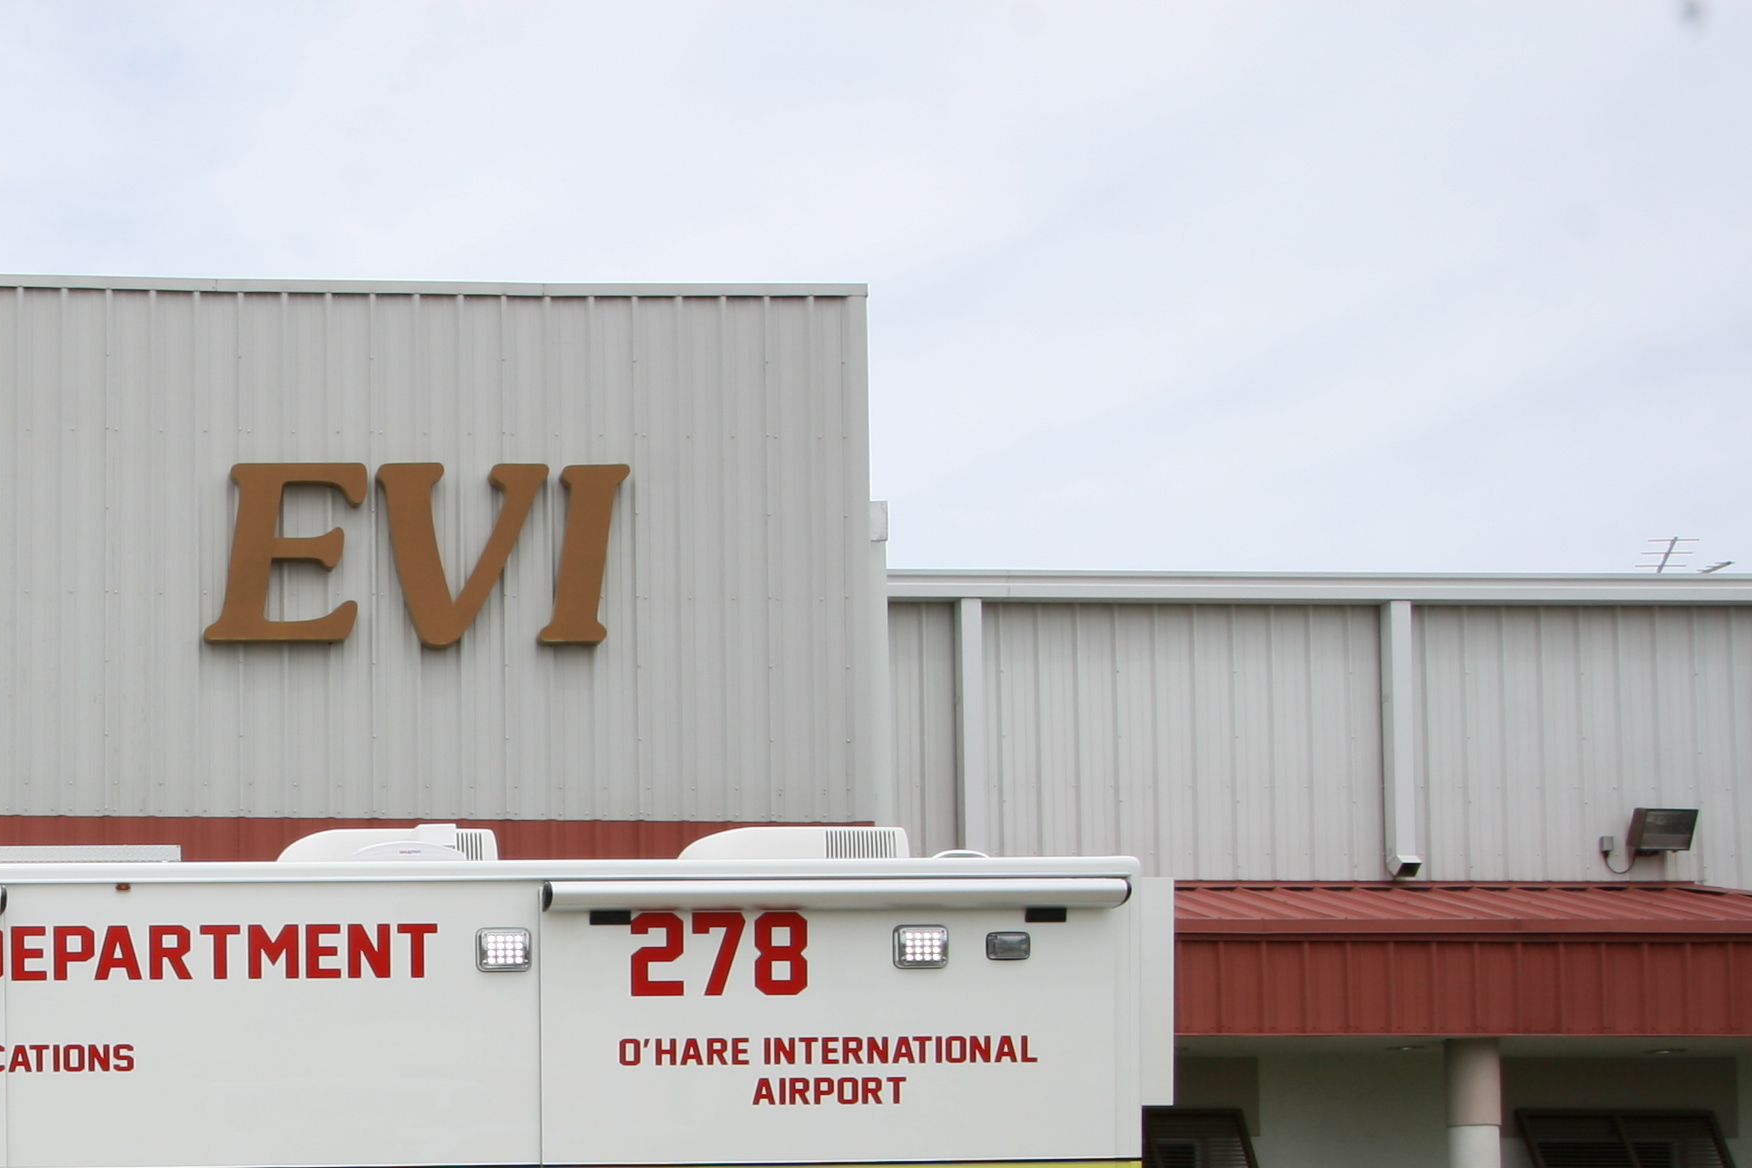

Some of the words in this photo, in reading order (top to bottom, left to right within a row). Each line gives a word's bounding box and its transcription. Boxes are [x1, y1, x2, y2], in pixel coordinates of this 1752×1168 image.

[204, 462, 631, 648] EVI
[630, 911, 808, 997] 278
[619, 1037, 750, 1066] O'HARE
[764, 1035, 1038, 1065] INTERNATIONAL
[752, 1077, 908, 1106] AIRPORT
